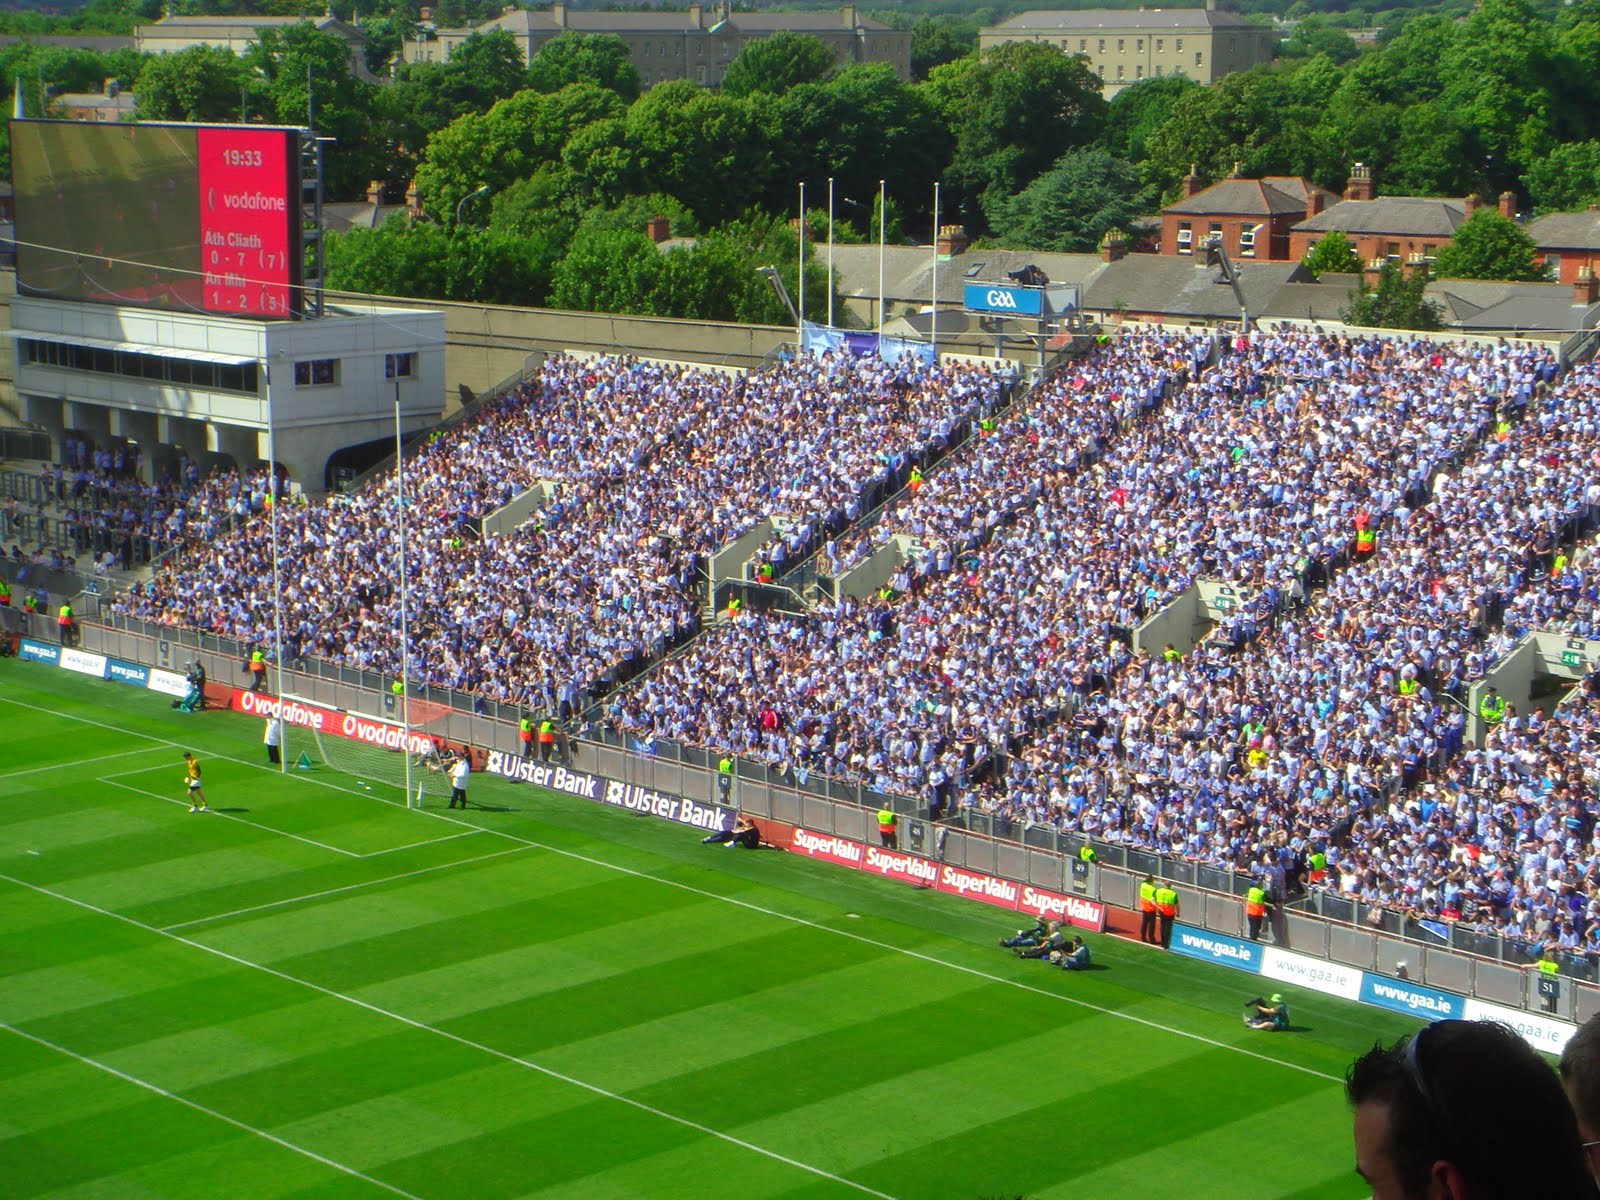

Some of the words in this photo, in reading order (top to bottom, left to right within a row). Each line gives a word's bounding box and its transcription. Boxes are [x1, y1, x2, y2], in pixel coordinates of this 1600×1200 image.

[223, 149, 263, 167] 19:33
[224, 191, 286, 211] vodafone
[227, 231, 262, 248] Cliath
[987, 289, 1017, 308] GAA
[23, 643, 57, 659] www.gaa.ie
[110, 664, 146, 680] www.gaa.ie
[255, 698, 324, 728] vodafone
[357, 721, 431, 755] vodafone
[503, 754, 552, 786] Ulster
[553, 766, 597, 797] Bank
[624, 785, 678, 818] Ulster
[680, 798, 727, 831] Bank
[793, 829, 861, 861] SuperValu
[866, 848, 938, 881] SuperValu
[1075, 863, 1086, 873] 49
[941, 866, 1017, 901] SuperValu
[1022, 887, 1101, 923] SuperValu
[1181, 932, 1251, 961] www.gaa.ie
[1276, 958, 1347, 987] www.gaa.ie
[1373, 982, 1451, 1015] www.gaa.ie
